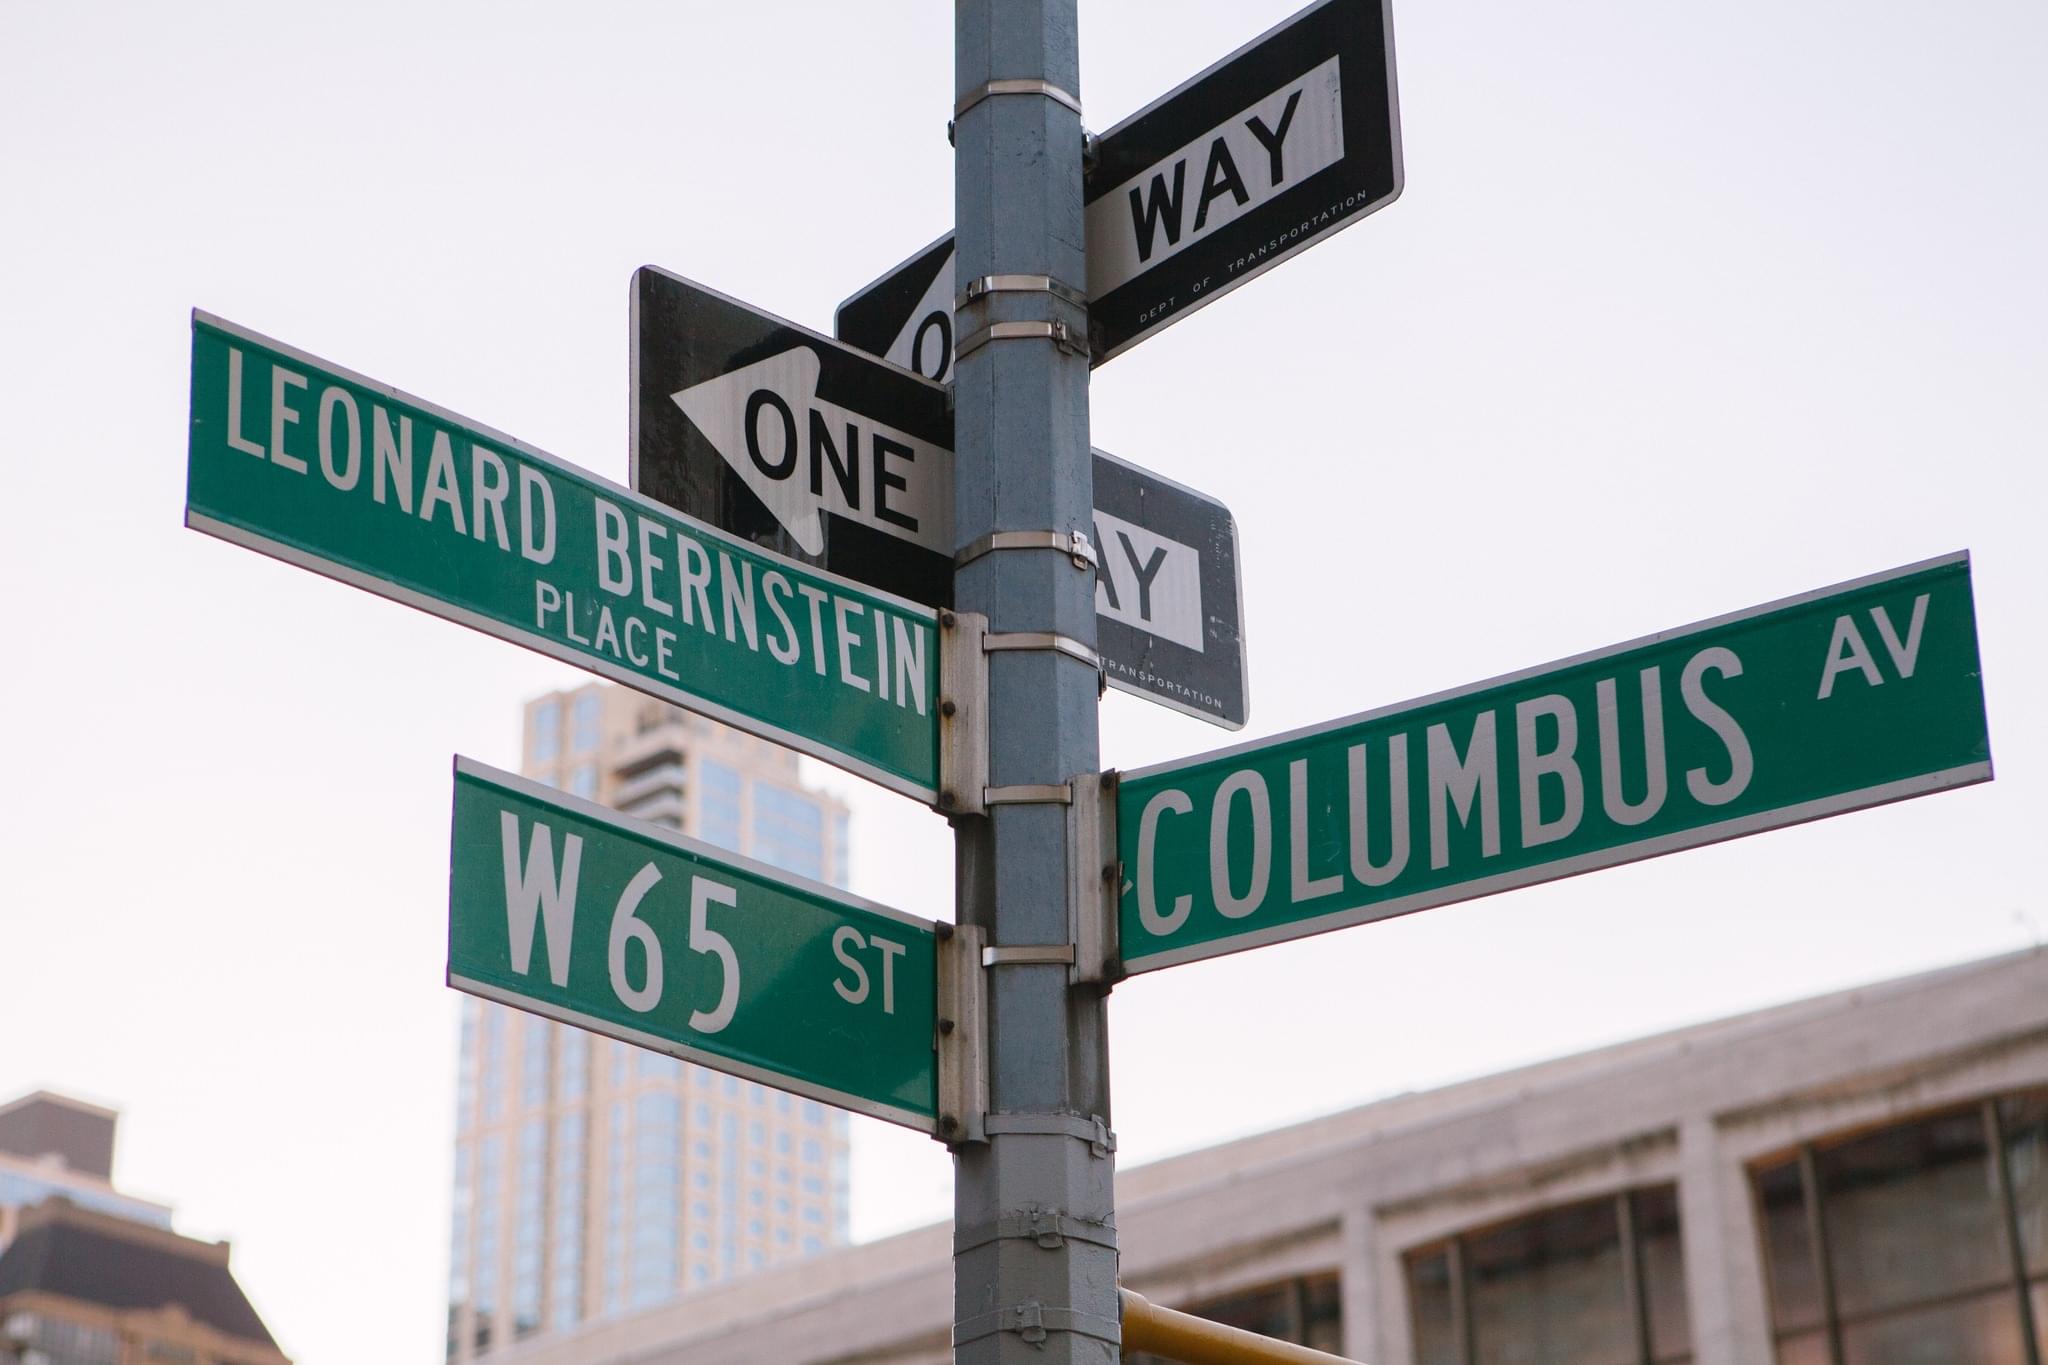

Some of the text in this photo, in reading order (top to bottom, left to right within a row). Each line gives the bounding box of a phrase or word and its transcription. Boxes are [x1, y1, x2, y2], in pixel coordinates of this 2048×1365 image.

[1128, 89, 1302, 263] WAY
[1139, 190, 1367, 324] DEPT OF TRANSPORTATION
[227, 347, 926, 716] LEONARD BERNSTEIN
[744, 388, 919, 533] ONE
[536, 580, 680, 681] PLACE
[1100, 656, 1222, 709] TRANSPORTATION
[1137, 593, 1931, 937] COLUMBUS AV
[501, 809, 906, 1034] W 65 ST
